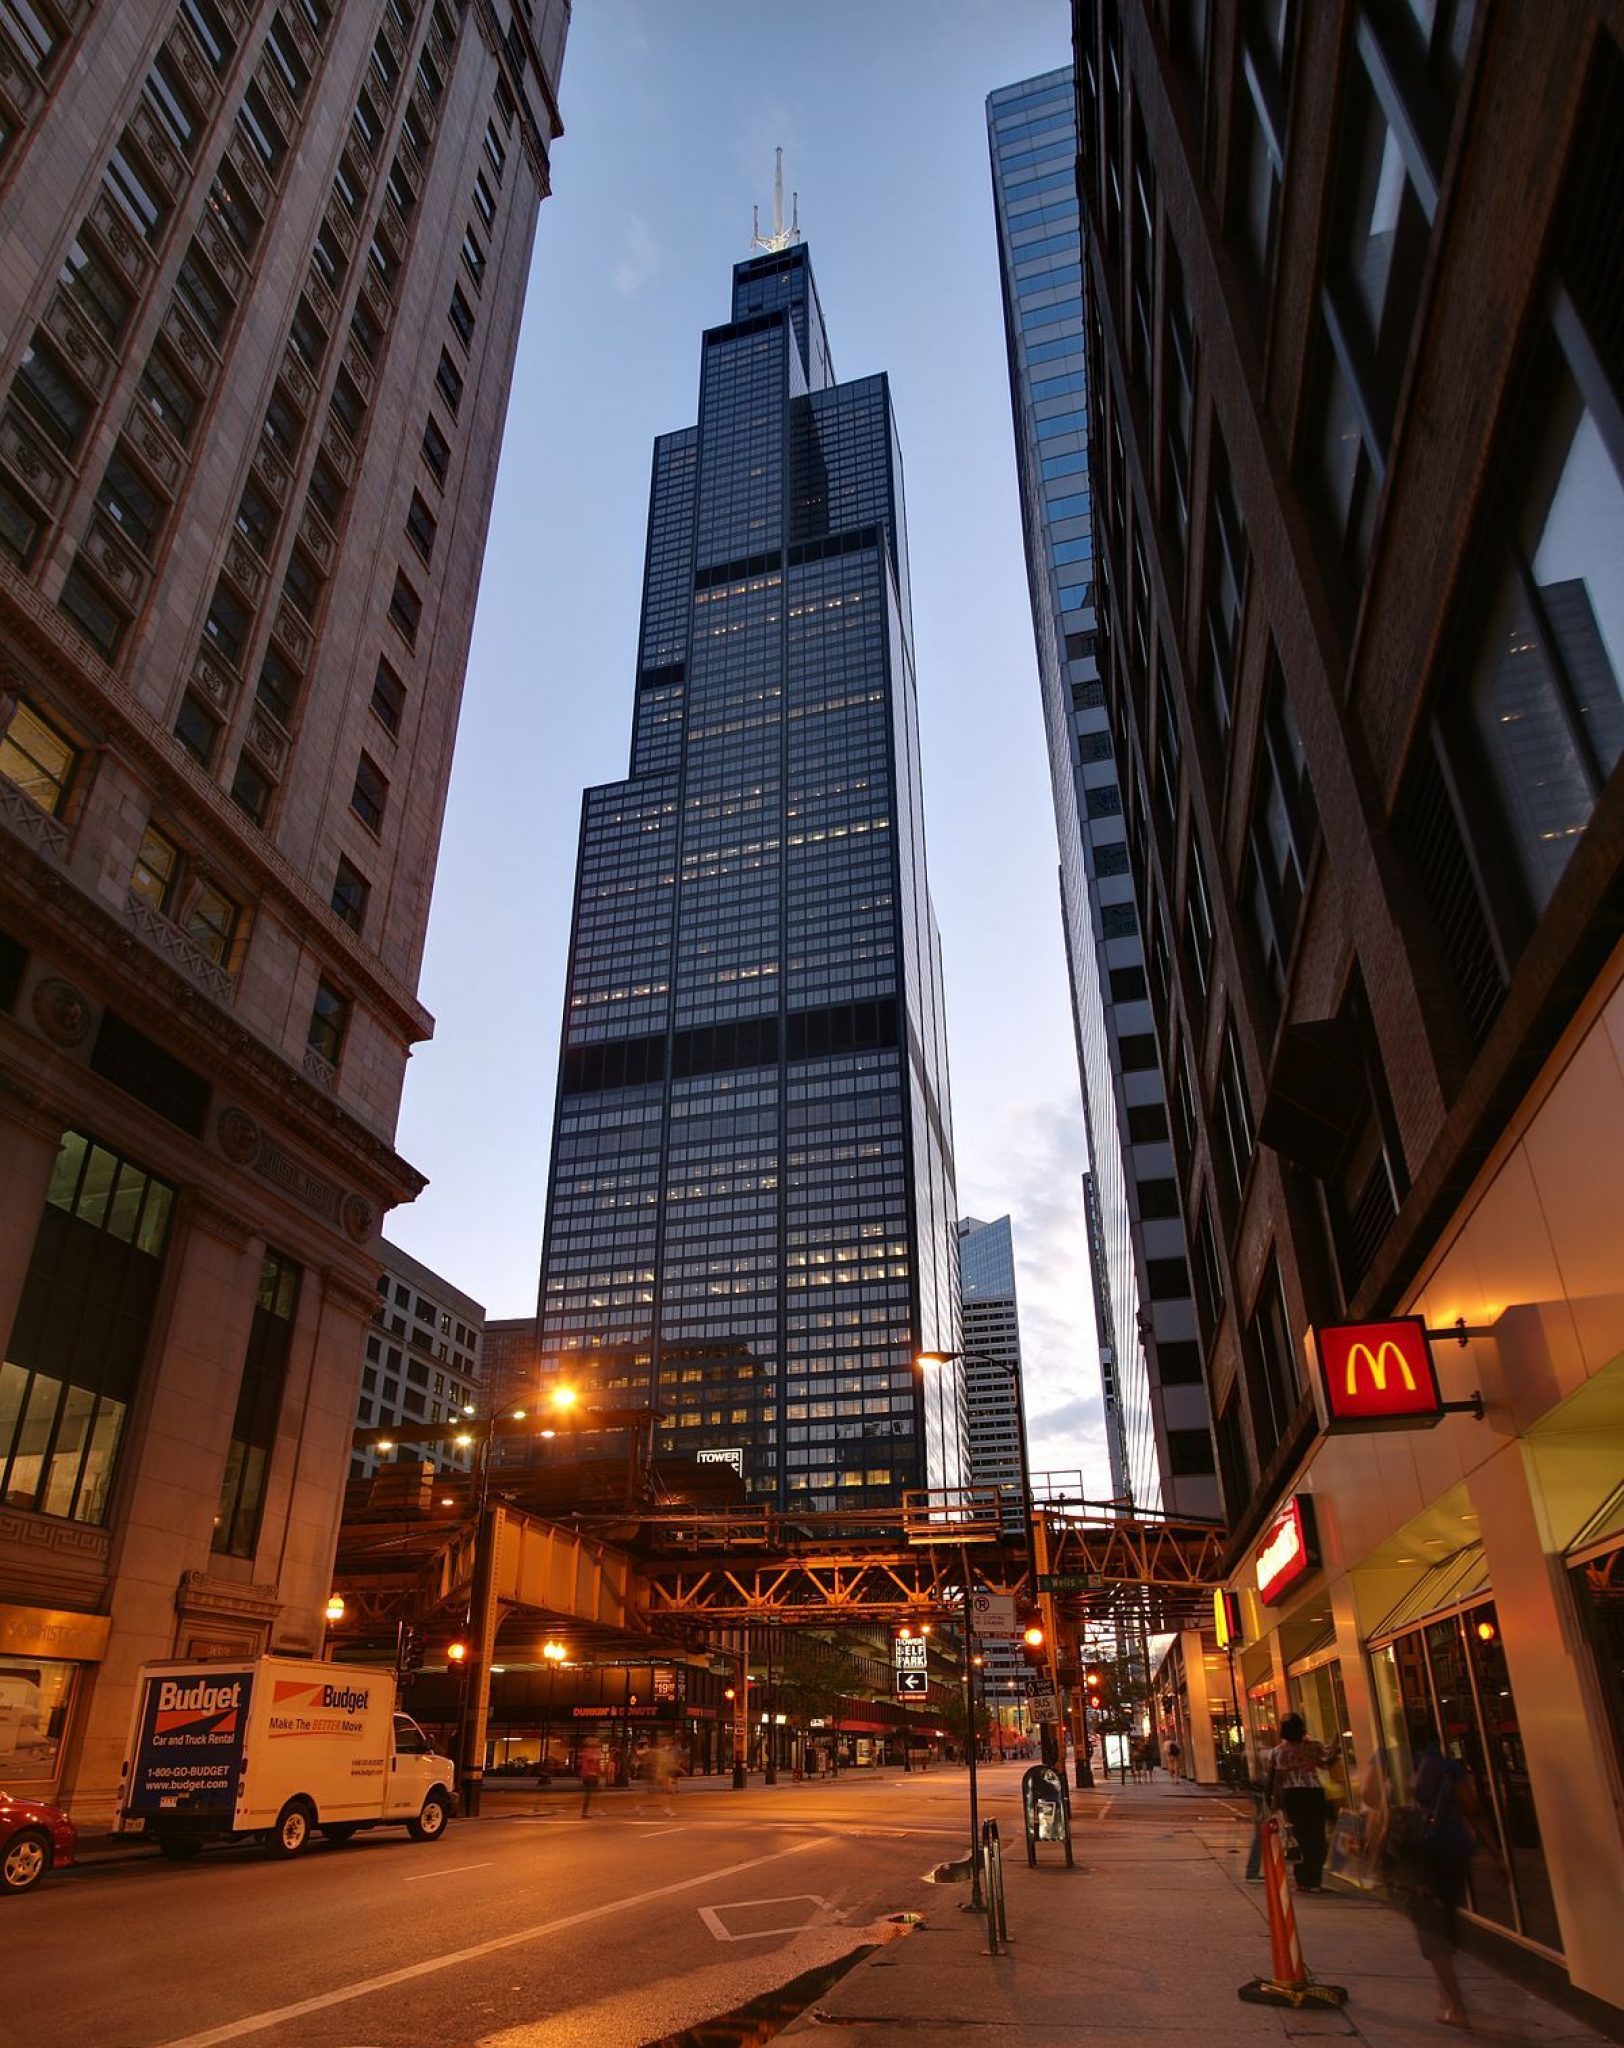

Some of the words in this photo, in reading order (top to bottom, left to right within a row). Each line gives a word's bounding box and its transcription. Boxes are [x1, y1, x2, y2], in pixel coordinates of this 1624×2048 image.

[700, 1451, 740, 1463] TOWER
[1051, 1577, 1076, 1587] Wells
[897, 1646, 924, 1655] SELF
[897, 1656, 924, 1667] PARK
[159, 1681, 241, 1715] Budget
[323, 1684, 369, 1714] Budget
[1034, 1697, 1050, 1708] BUS
[269, 1717, 294, 1729] Make
[296, 1718, 311, 1730] The
[312, 1719, 341, 1730] BETTER
[341, 1721, 364, 1732] Move
[152, 1735, 167, 1746] Car
[168, 1734, 184, 1745] and
[185, 1734, 206, 1745] Truck
[208, 1733, 235, 1744] Rental
[147, 1765, 230, 1777] 1-800-GO-BUDGET
[145, 1779, 228, 1791] www.budget.com
